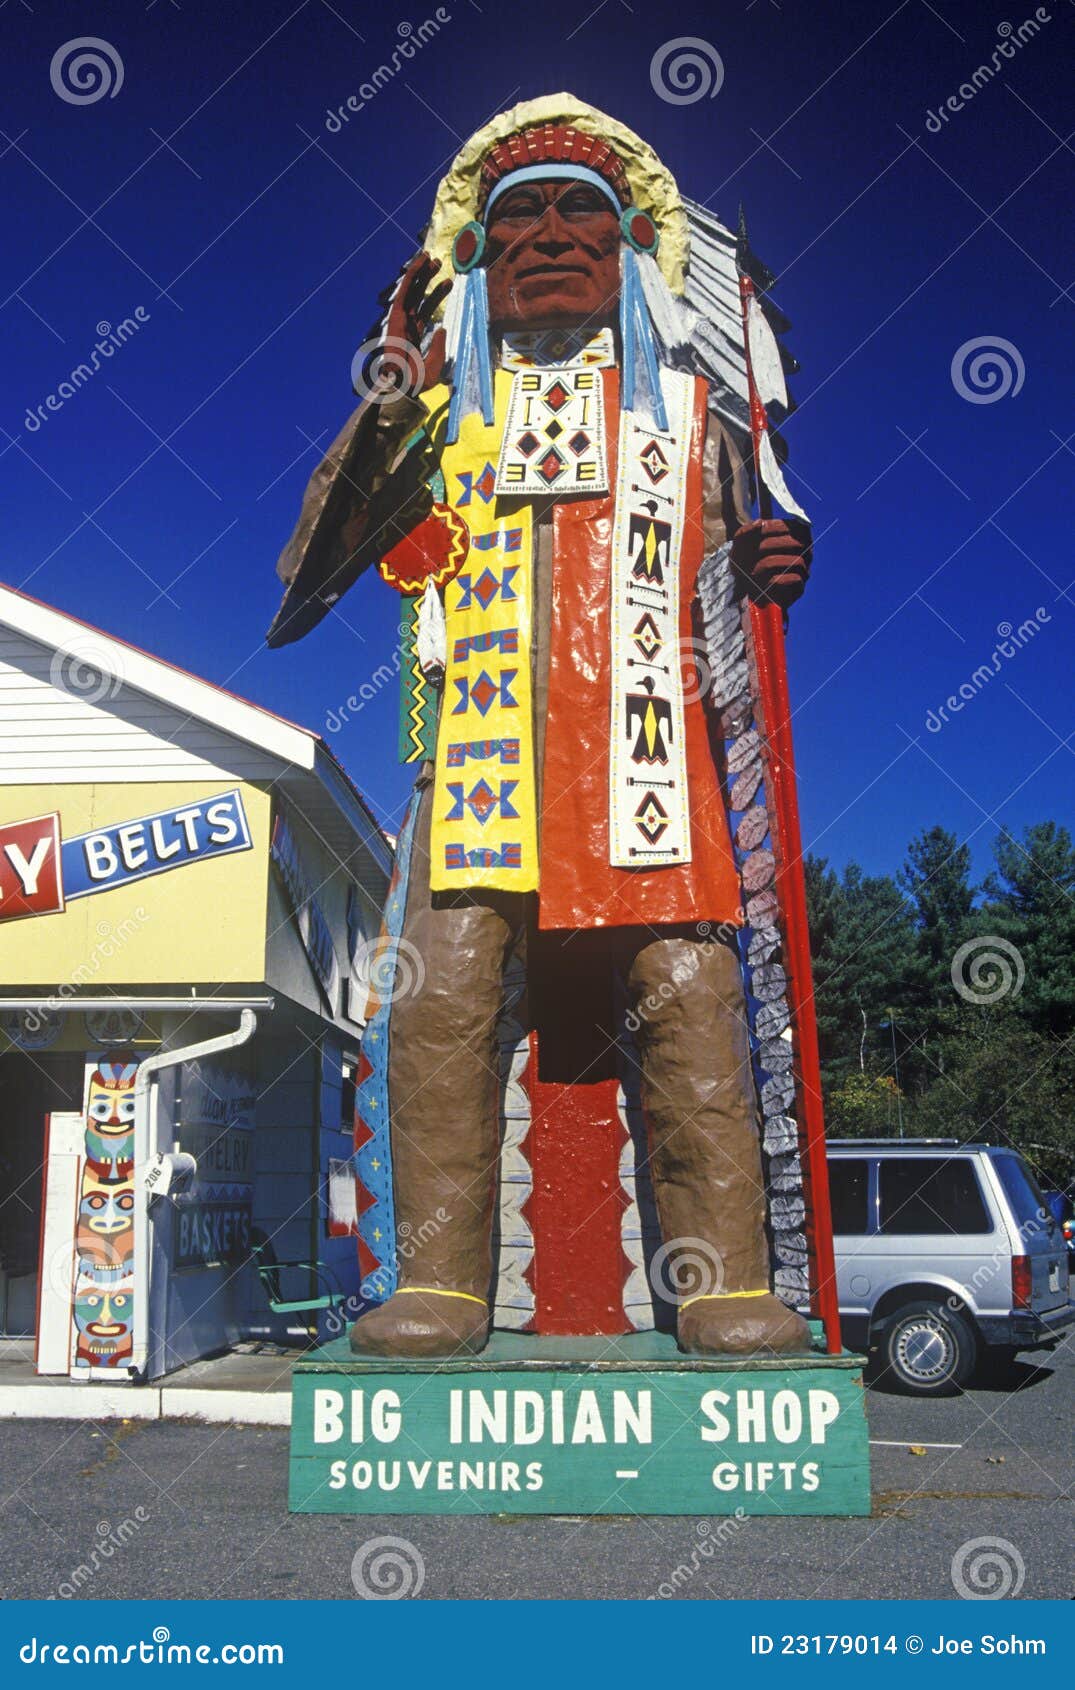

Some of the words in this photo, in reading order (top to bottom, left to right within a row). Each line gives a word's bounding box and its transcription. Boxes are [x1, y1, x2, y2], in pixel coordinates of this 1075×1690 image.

[84, 802, 239, 881] BELTS
[179, 1212, 250, 1257] BASKETS
[313, 1389, 402, 1444] BIG
[450, 1389, 652, 1445] INDIAN
[700, 1389, 840, 1445] SHOP
[329, 1460, 543, 1492] SOUVENIRS
[712, 1462, 820, 1492] GIFTS
